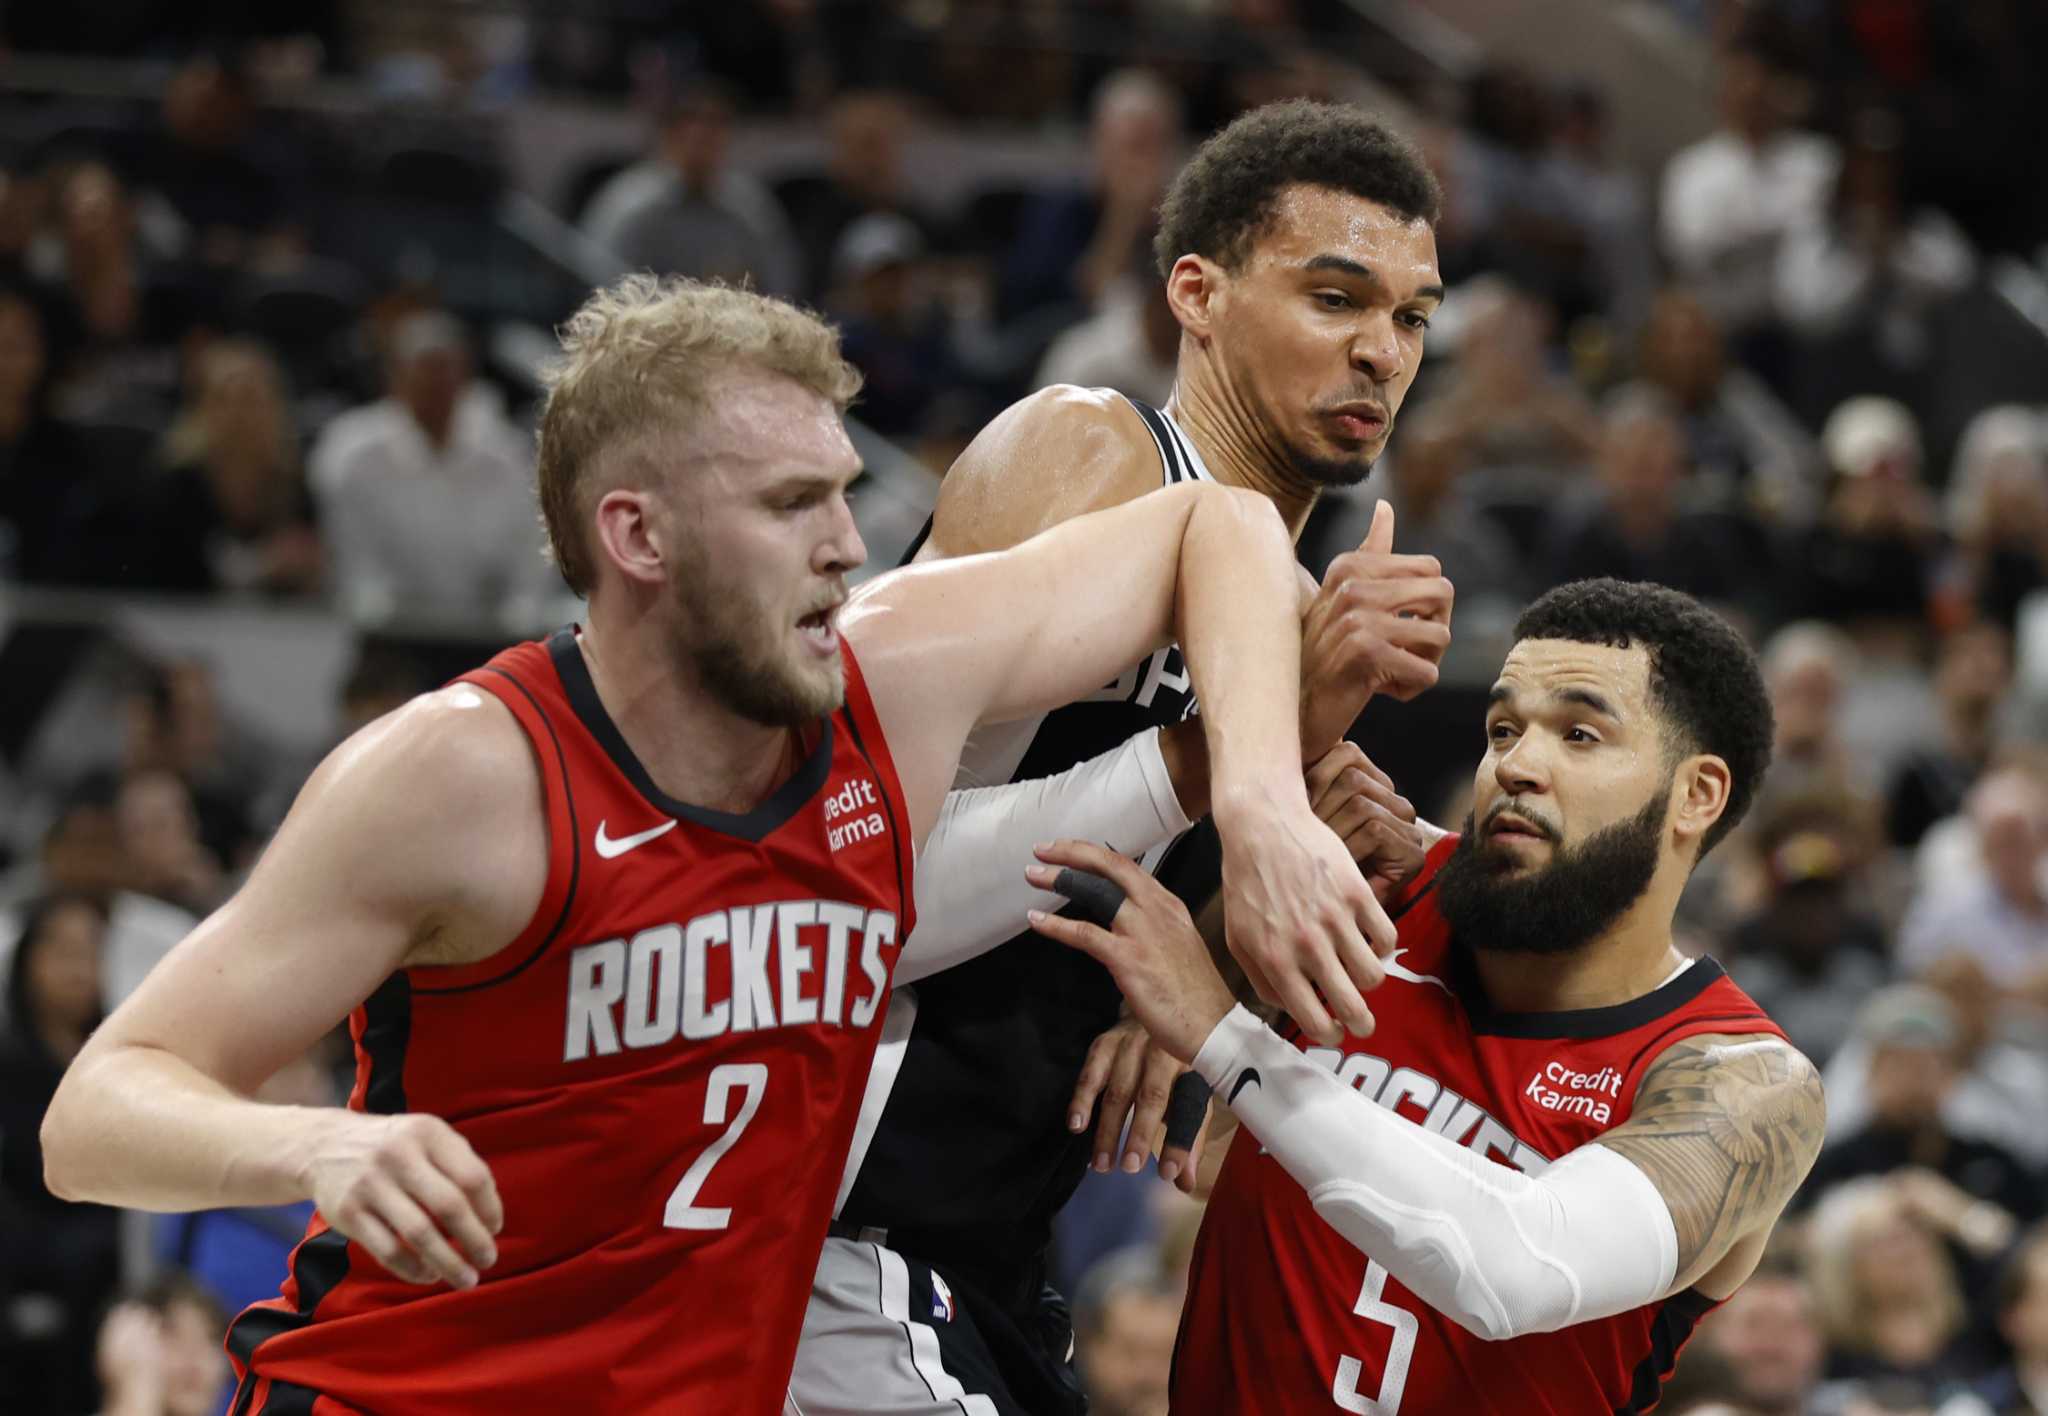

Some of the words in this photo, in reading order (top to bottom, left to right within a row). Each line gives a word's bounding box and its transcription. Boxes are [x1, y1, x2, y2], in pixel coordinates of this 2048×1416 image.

[563, 899, 897, 1063] ROCKETS
[663, 1063, 768, 1230] 2
[1525, 1073, 1611, 1125] karma
[1545, 1061, 1622, 1098] credit
[1333, 1257, 1419, 1416] 5
